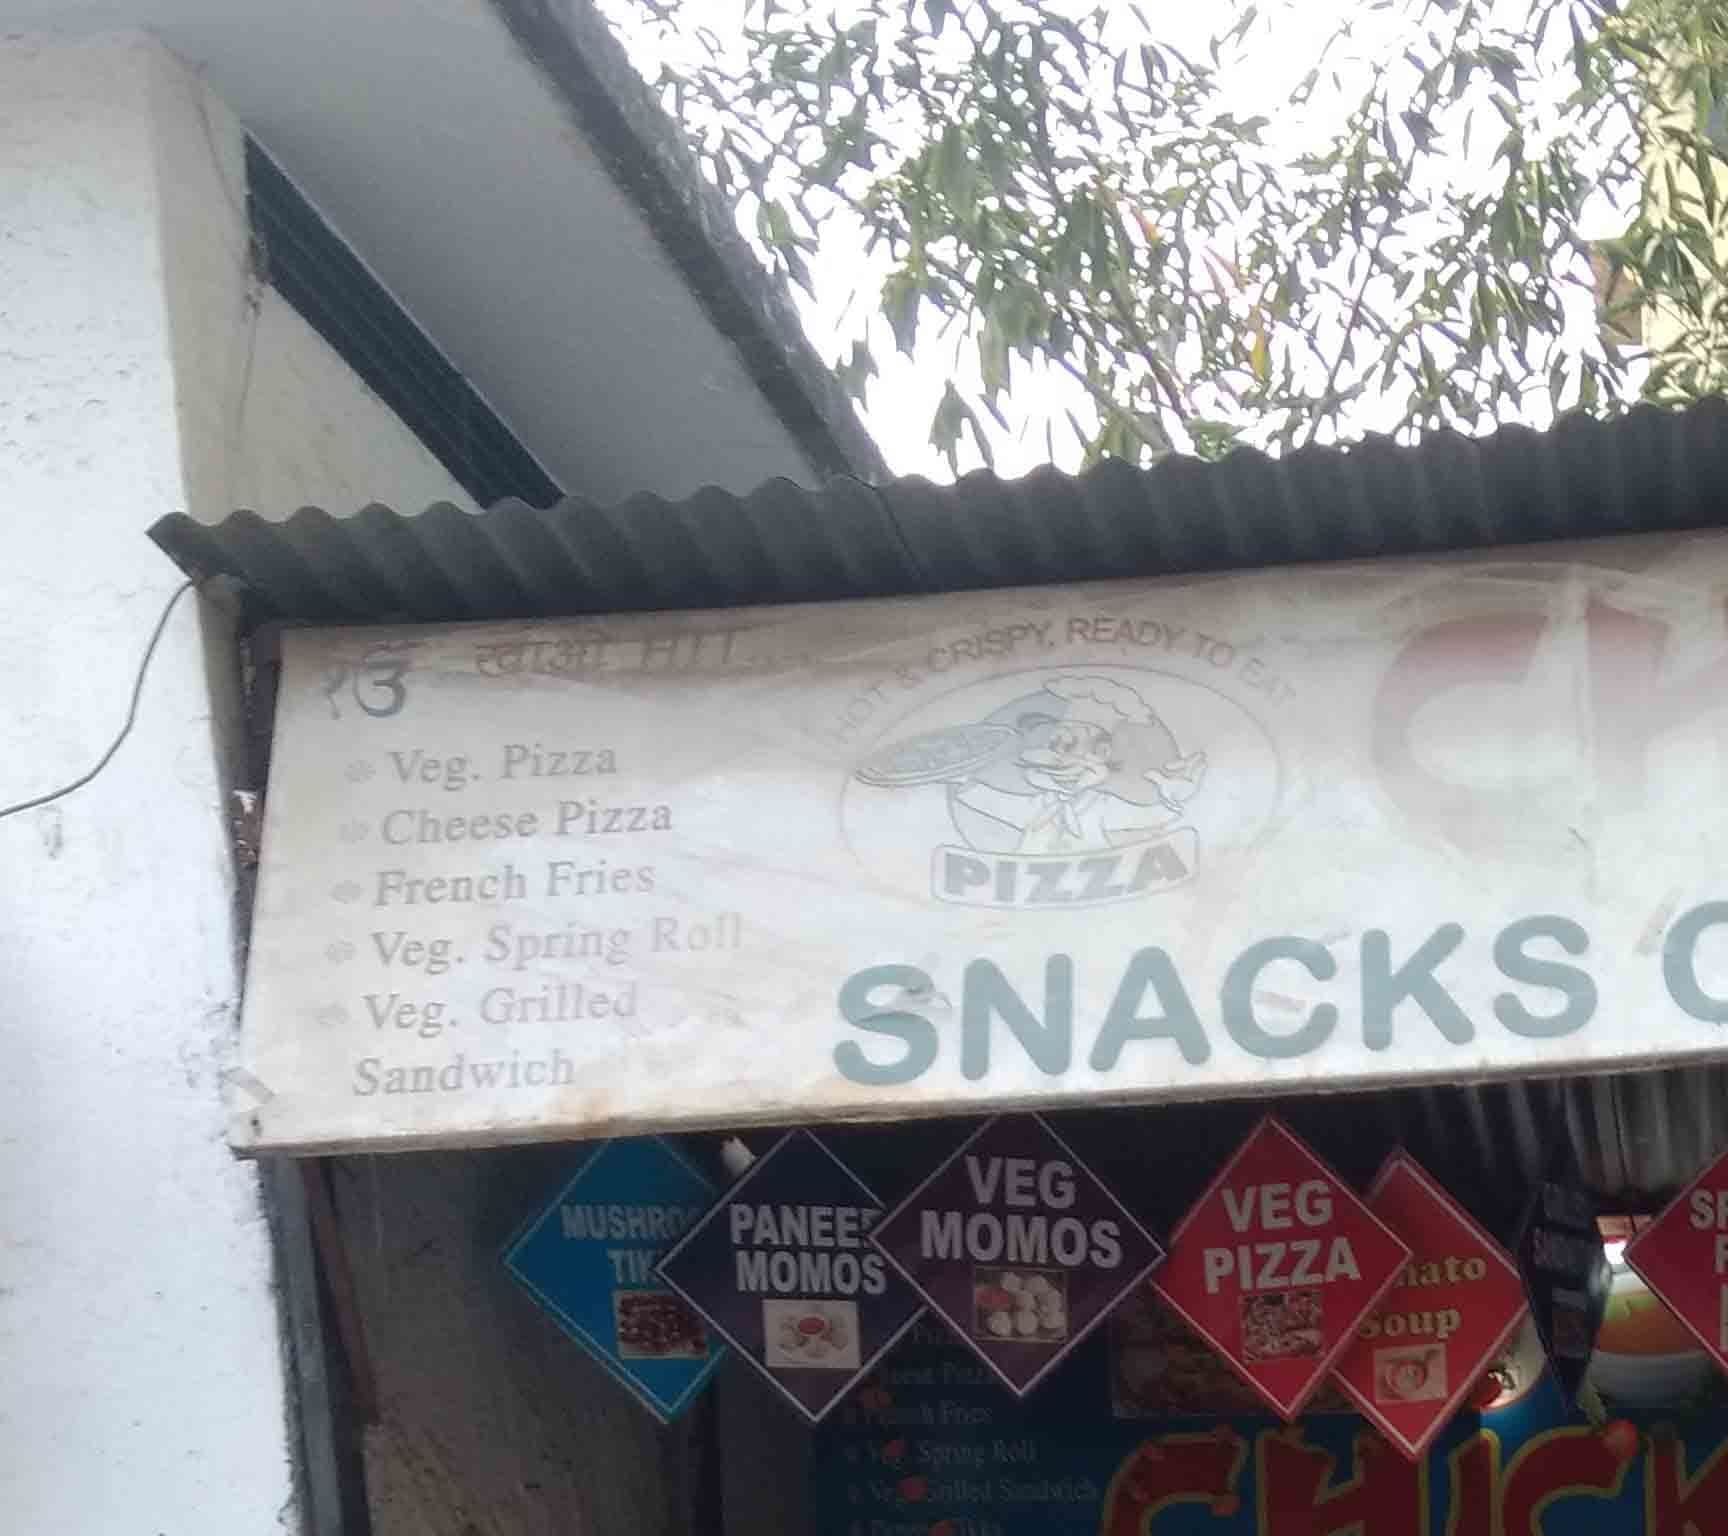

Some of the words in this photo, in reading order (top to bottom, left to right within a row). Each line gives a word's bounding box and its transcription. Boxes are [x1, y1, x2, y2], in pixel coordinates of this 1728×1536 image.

[1068, 616, 1184, 651] READY
[1196, 633, 1235, 670] TO
[390, 749, 481, 792] Veg.
[501, 743, 618, 780] Pizza
[381, 807, 539, 847] Cheese
[556, 799, 672, 836] Pizza
[376, 865, 527, 906] French
[546, 859, 657, 897] Fries
[944, 840, 1188, 905] PIZZA
[370, 931, 464, 975] Veg.
[483, 921, 632, 970] Spring
[651, 911, 742, 953] Roll
[362, 993, 457, 1038] Veg.
[479, 981, 638, 1025] Grilled
[833, 912, 1599, 1086] SNACKS
[352, 1049, 576, 1097] Sandwich
[965, 1156, 1075, 1209] VEG
[1221, 1180, 1332, 1233] VEG
[560, 1203, 700, 1241] MUSHRO
[920, 1211, 1123, 1268] MOMOS
[736, 1250, 887, 1295] MOMOS
[1204, 1237, 1362, 1295] PIZZA
